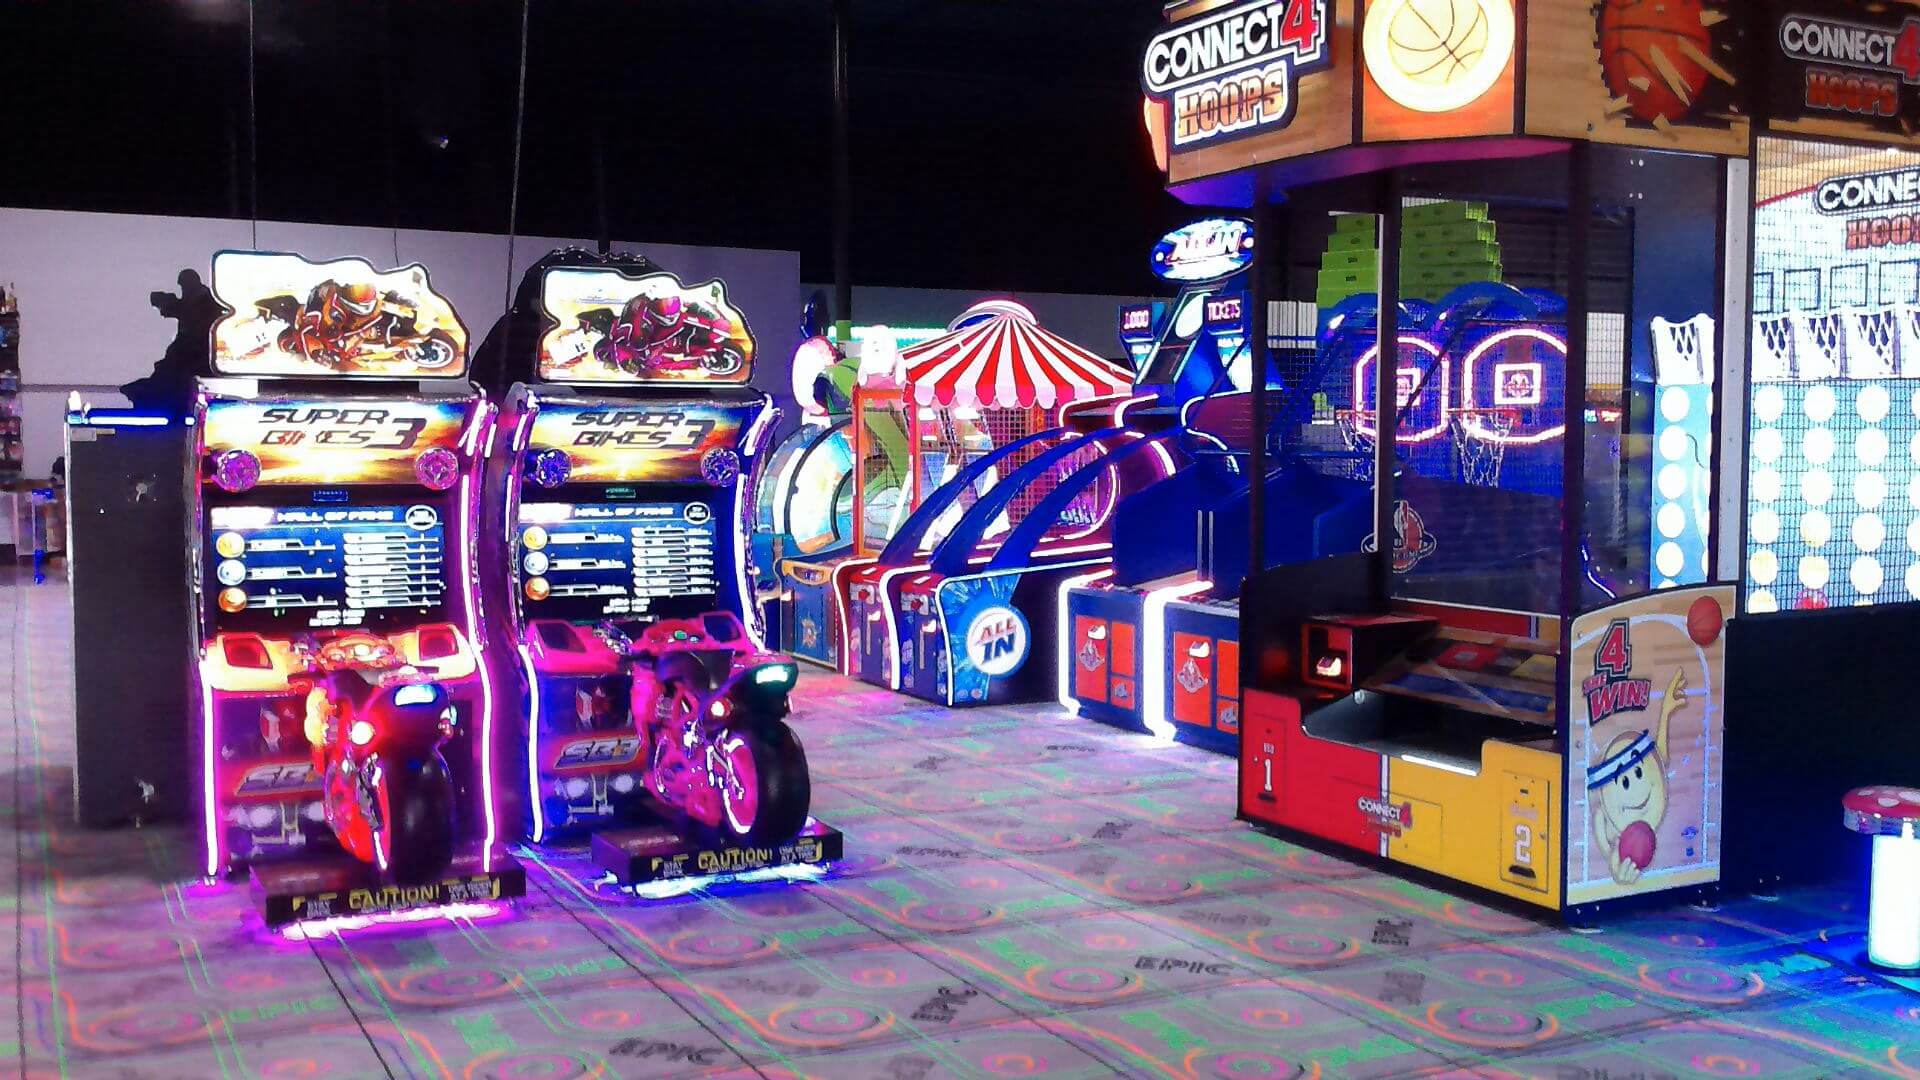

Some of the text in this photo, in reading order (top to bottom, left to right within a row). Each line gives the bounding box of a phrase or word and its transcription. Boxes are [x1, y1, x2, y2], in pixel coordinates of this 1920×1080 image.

[1148, 0, 1321, 86] CONNECT 4
[1781, 20, 1896, 67] CONNECT
[1175, 67, 1285, 139] HOOPS
[1818, 171, 1920, 211] CONNE
[259, 408, 428, 450] SUPER 3
[571, 411, 716, 450] SUPER 3
[571, 430, 673, 447] BIKES
[979, 617, 1017, 641] ALL
[980, 632, 1016, 665] IN
[1597, 619, 1631, 677] 4
[1588, 679, 1649, 722] WIN!
[1264, 758, 1273, 792] 1
[1358, 797, 1401, 821] CONNECT
[698, 848, 773, 870] CAUTION!
[1514, 823, 1532, 865] 2
[349, 884, 440, 910] CAUTION!
[1134, 955, 1232, 976] EPIC
